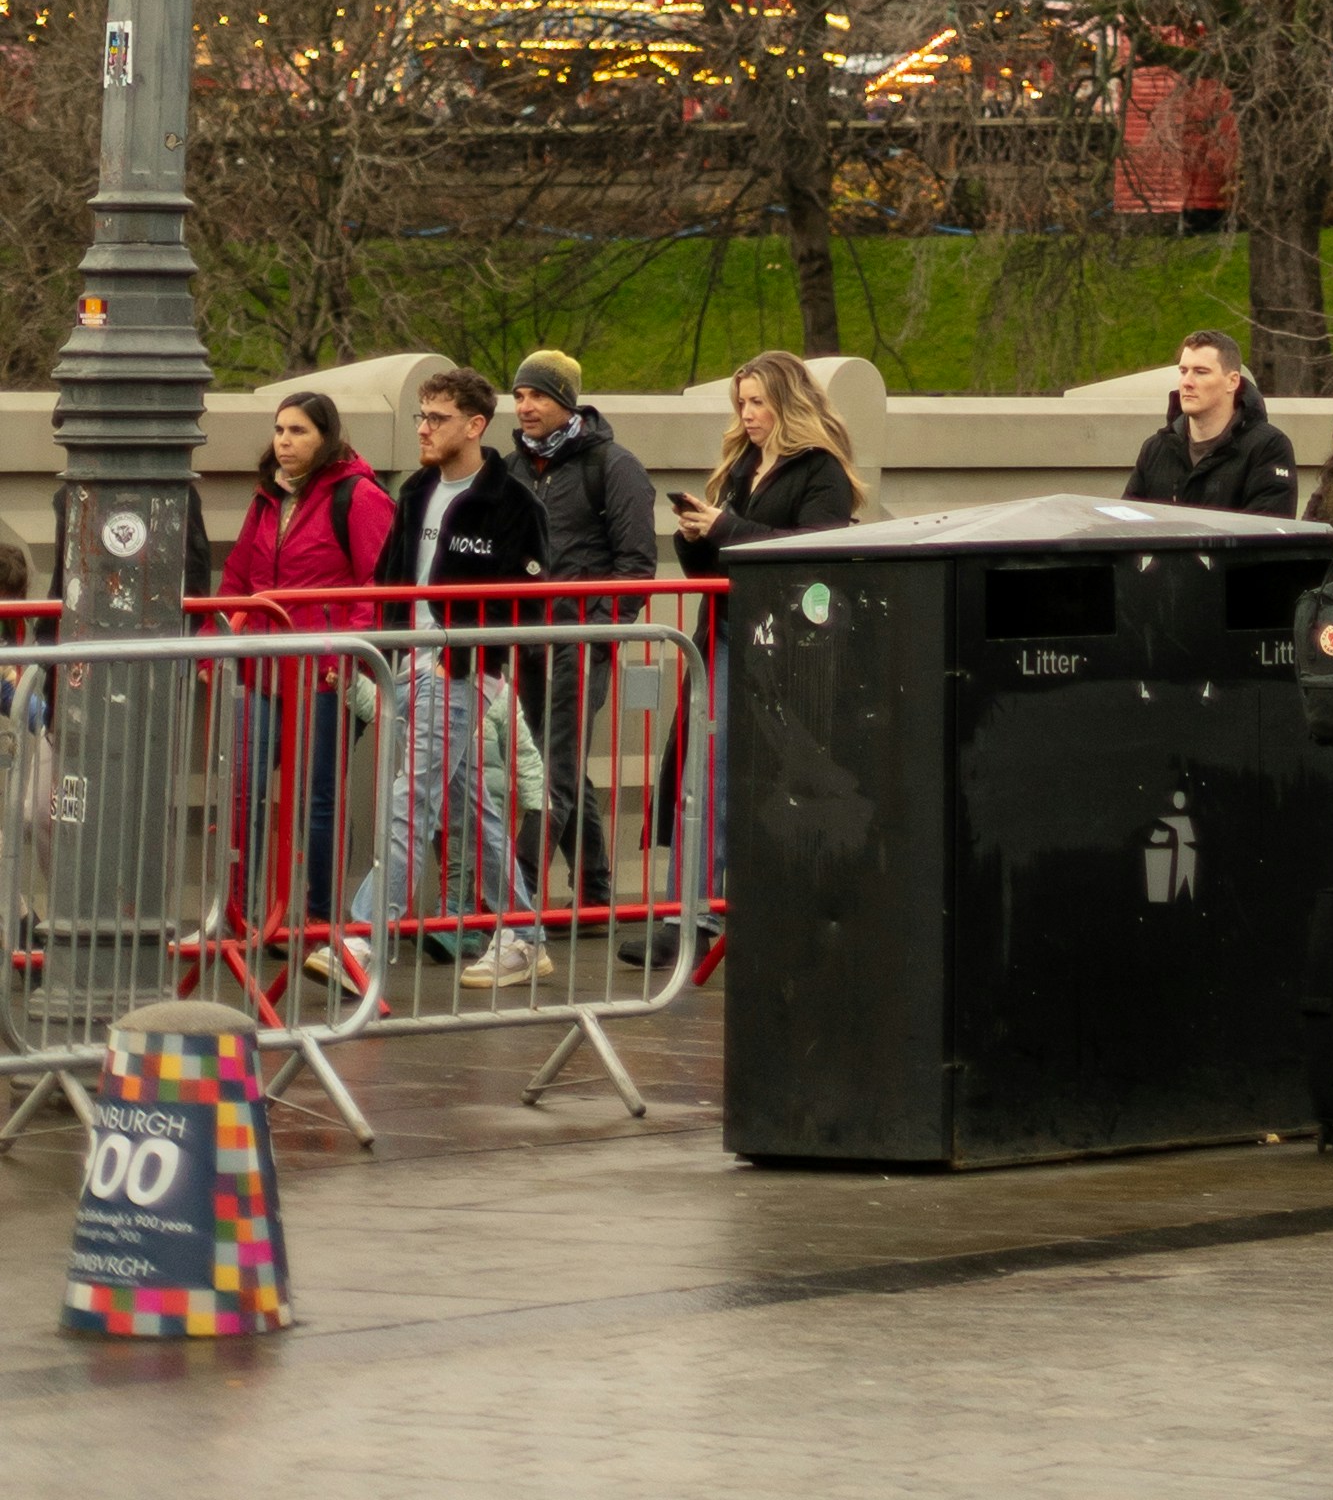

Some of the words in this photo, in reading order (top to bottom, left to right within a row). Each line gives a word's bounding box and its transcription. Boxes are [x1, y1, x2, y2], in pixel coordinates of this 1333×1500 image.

[1022, 651, 1080, 675] Litter
[1261, 642, 1295, 665] Litt
[98, 1106, 186, 1138] NBURGH
[80, 1130, 179, 1206] 00
